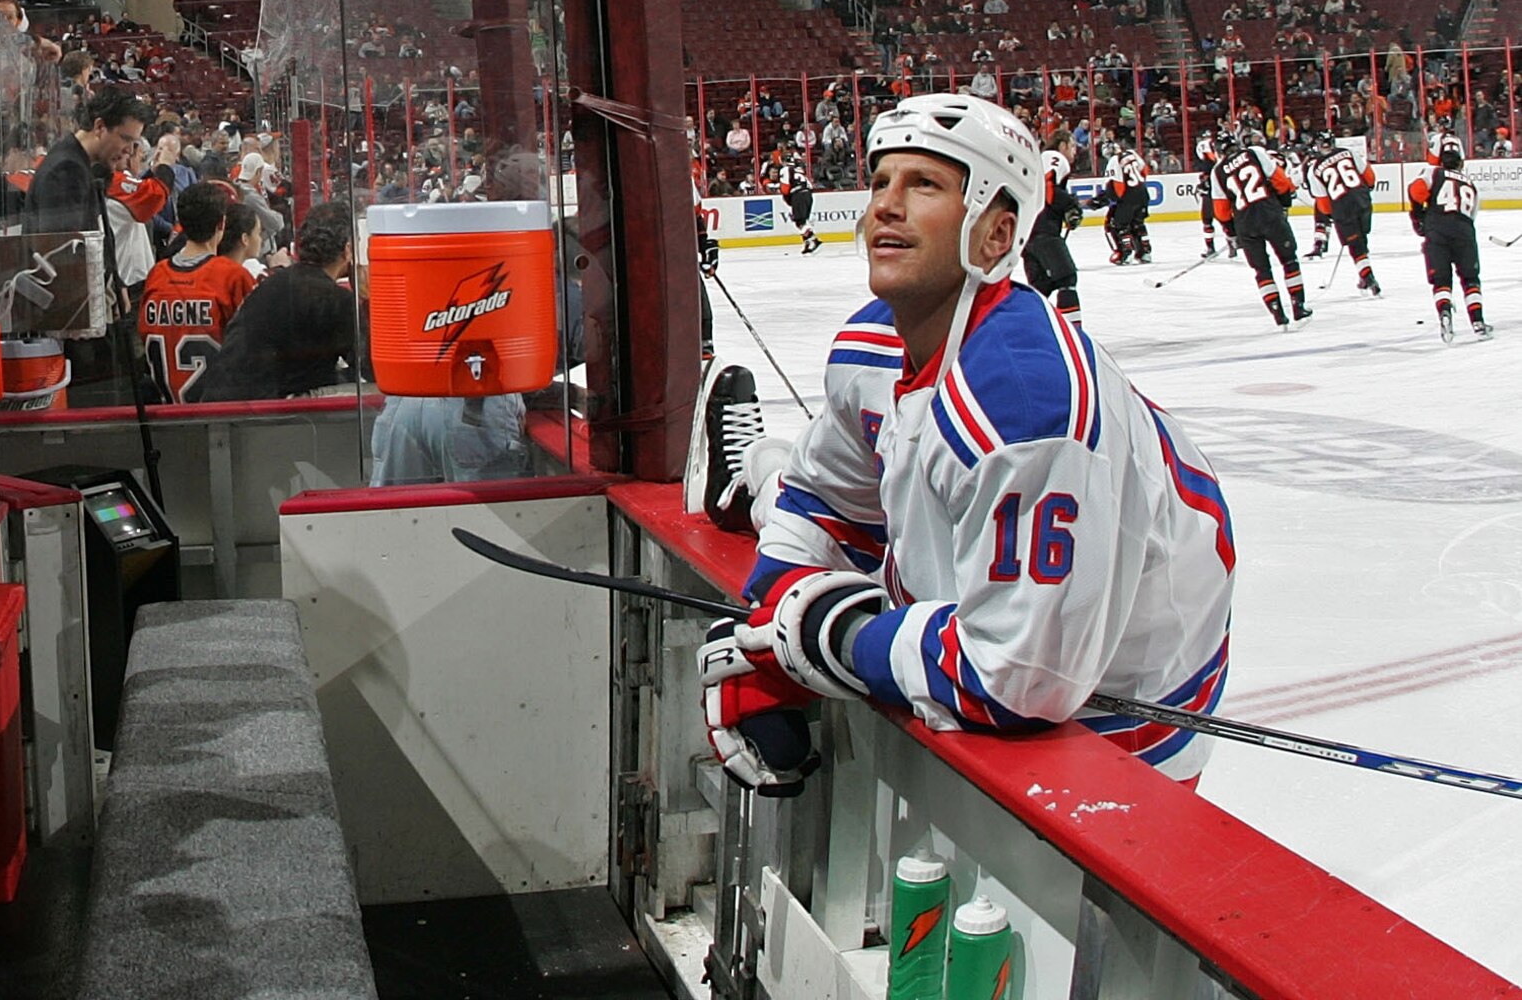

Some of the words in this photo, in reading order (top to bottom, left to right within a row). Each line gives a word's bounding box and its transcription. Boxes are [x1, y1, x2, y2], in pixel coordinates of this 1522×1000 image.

[1226, 165, 1268, 210] 12
[1321, 158, 1361, 200] 26
[1436, 179, 1477, 218] 48
[145, 299, 214, 326] GAGNE
[423, 291, 512, 332] Gatorade
[145, 333, 223, 404] 12
[988, 491, 1080, 585] 16
